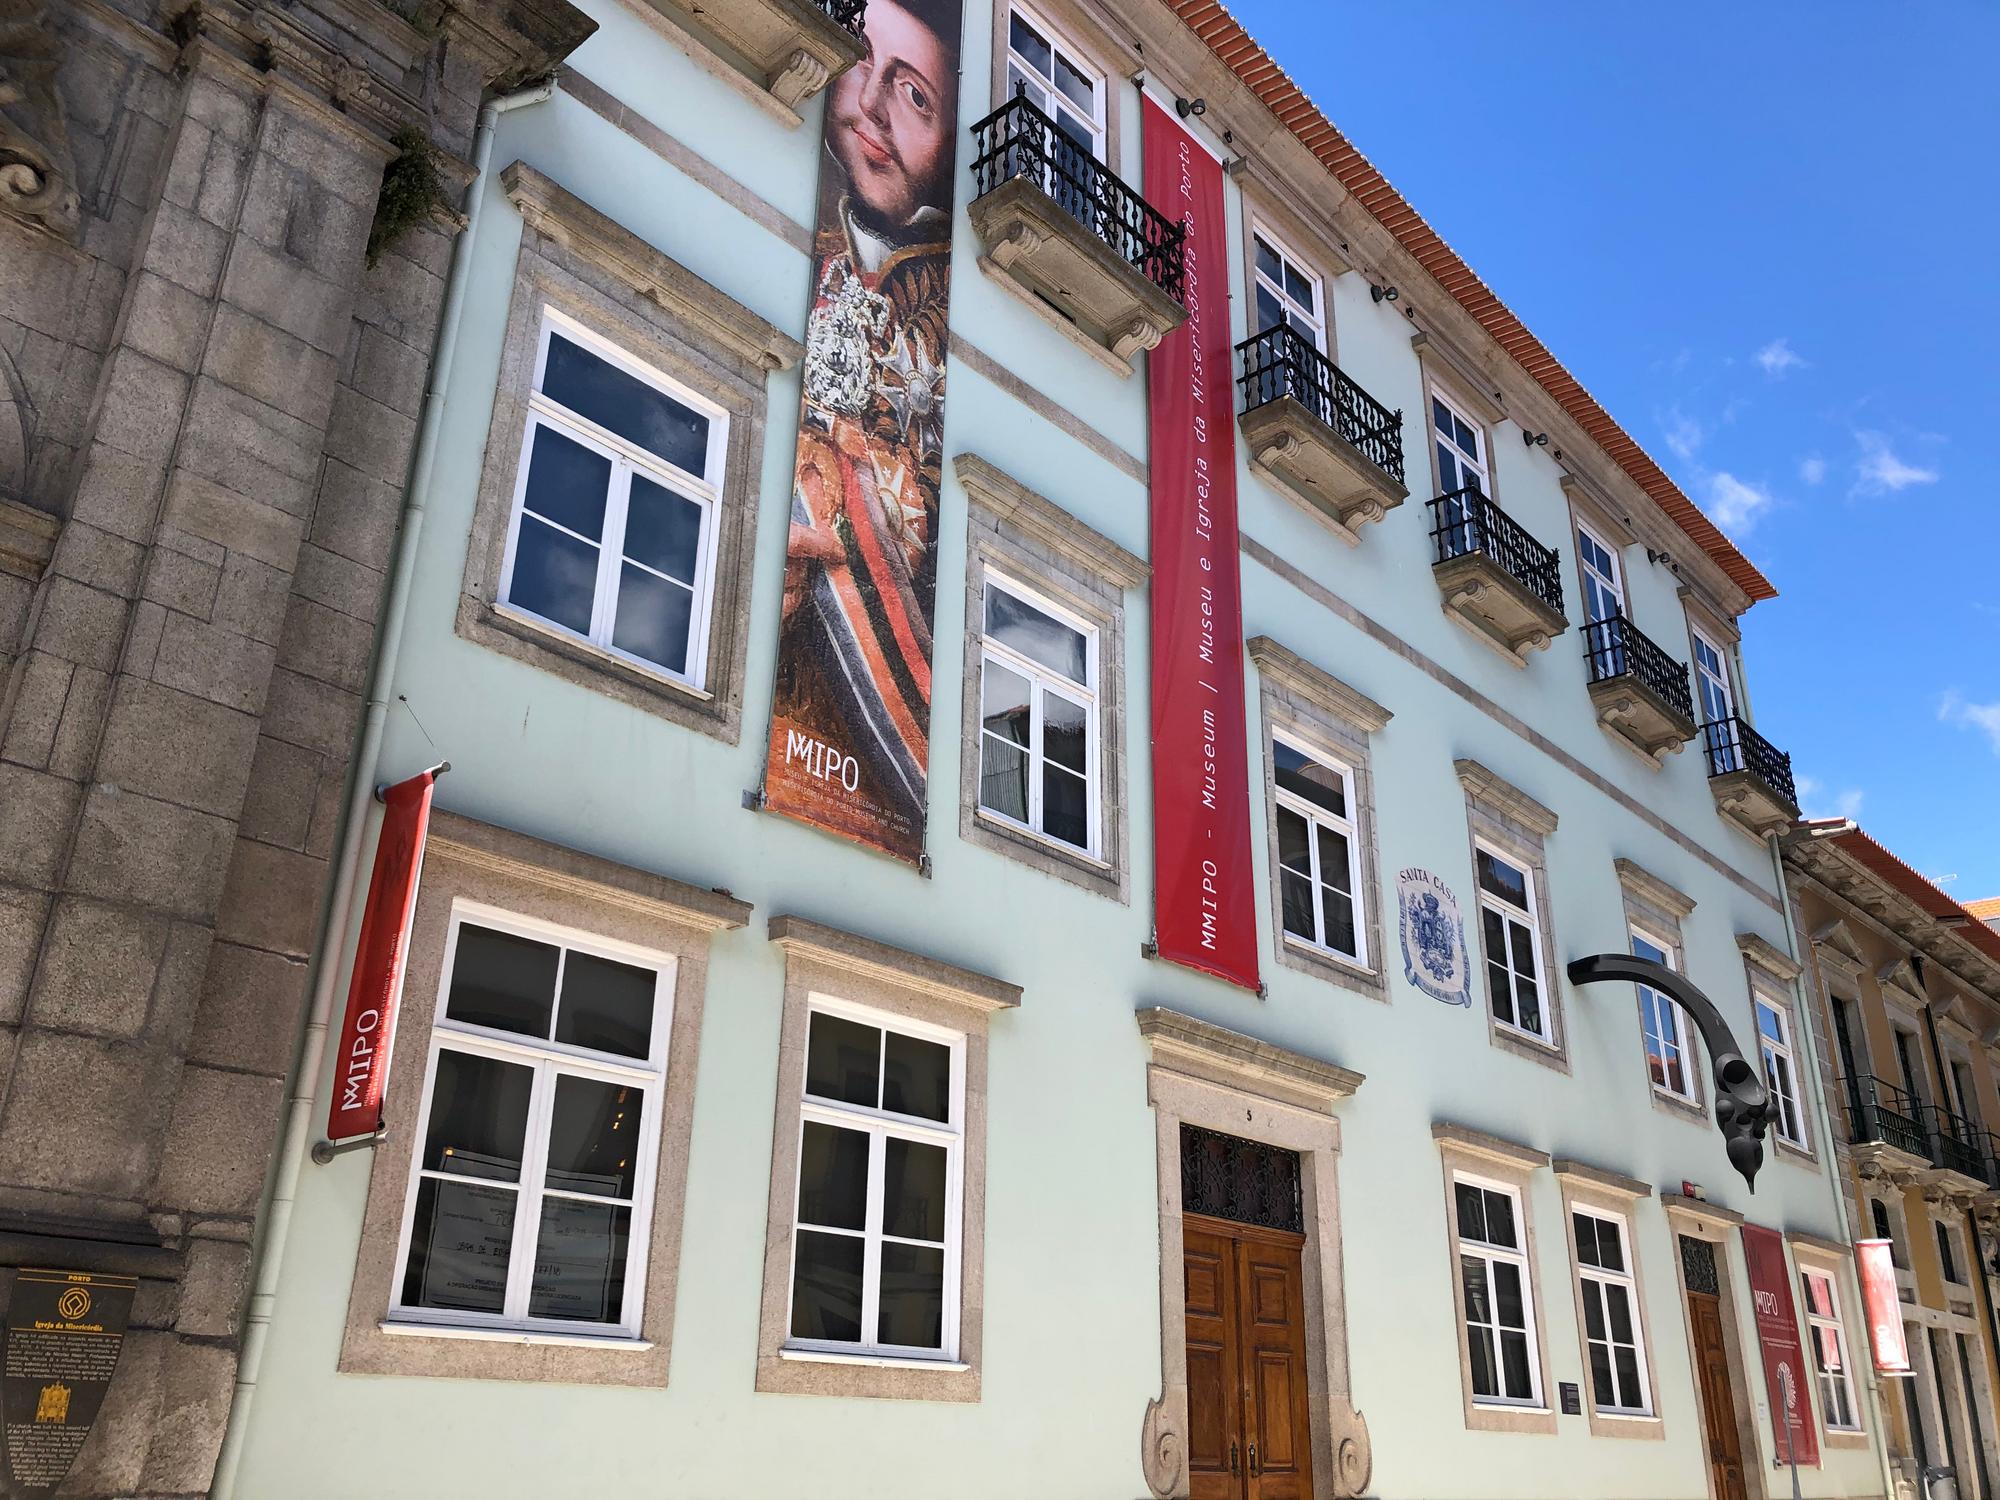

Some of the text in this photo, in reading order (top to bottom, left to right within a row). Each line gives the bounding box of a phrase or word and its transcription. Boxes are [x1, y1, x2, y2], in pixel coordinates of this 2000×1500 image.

[1180, 142, 1190, 201] Porto
[1185, 209, 1194, 236] do
[1187, 247, 1204, 404] Misericórdia
[1195, 417, 1207, 443] da
[1194, 457, 1212, 541] Igreja
[1200, 557, 1211, 571] e
[1199, 587, 1213, 664] Museu
[1202, 710, 1216, 809] Museum
[884, 809, 892, 817] DO
[890, 822, 910, 835] CHURCH
[1201, 860, 1217, 950] MMIPO
[1400, 867, 1457, 908] SANTA CASA
[35, 1320, 103, 1332] Igreja da Misericórdia
